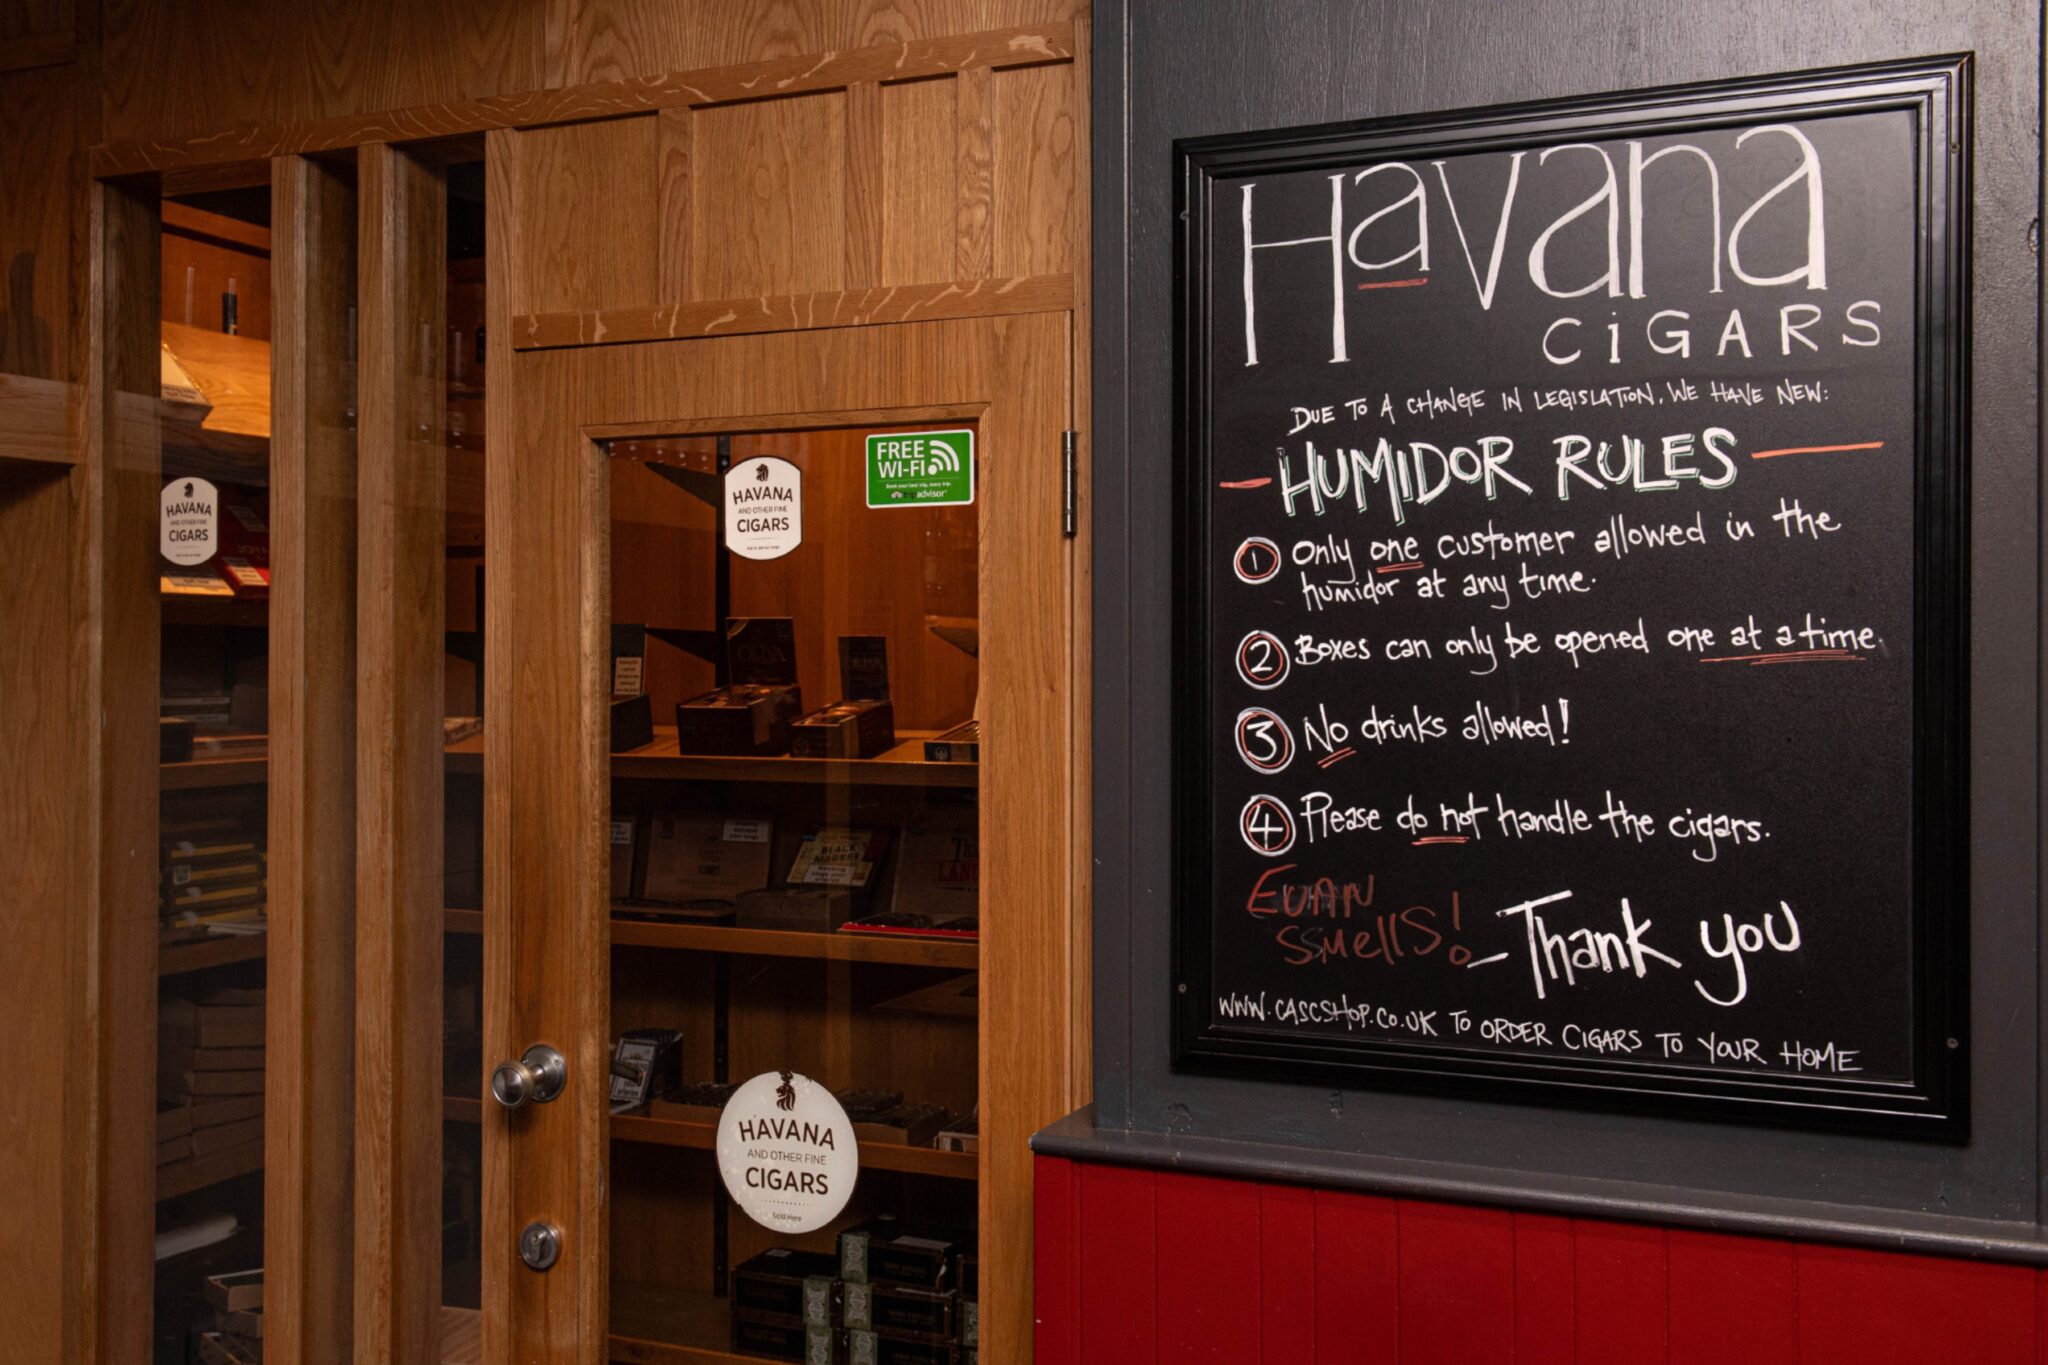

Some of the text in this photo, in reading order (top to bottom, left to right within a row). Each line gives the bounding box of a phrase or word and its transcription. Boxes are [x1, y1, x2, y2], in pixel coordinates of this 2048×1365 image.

[1240, 123, 1828, 366] Havana
[1286, 405, 1336, 436] DUE
[1380, 392, 1396, 425] A
[1406, 386, 1486, 420] CHANGE
[1501, 386, 1523, 413] IN
[1667, 378, 1699, 404] WE
[1710, 380, 1764, 407] HAVE
[877, 440, 925, 461] FREE
[877, 460, 926, 479] WI-FI
[1276, 427, 1739, 527] HUMIDOR RULES
[166, 502, 212, 518] HAVANA
[733, 486, 793, 505] HAVANA
[738, 505, 788, 514] AND OTHER FINE
[168, 529, 209, 542] CIGARS
[737, 517, 790, 533] CIGARS
[1292, 534, 1356, 584] Only
[1370, 536, 1420, 563] one
[1437, 519, 1575, 561] customer
[1594, 510, 1706, 560] allowed
[1726, 511, 1756, 541] in
[1772, 497, 1842, 540] the
[1301, 561, 1597, 611] humidor at any time.
[1294, 634, 1372, 665] Boxes
[1386, 637, 1433, 660] can
[1445, 625, 1498, 676] only
[1503, 621, 1541, 659] be
[1554, 616, 1650, 669] opened
[1666, 625, 1716, 652] one
[1730, 614, 1763, 650] at
[1775, 625, 1796, 646] a
[1302, 703, 1349, 752] No
[1360, 704, 1448, 745] drinks
[1462, 697, 1570, 746] allowed!
[1300, 791, 1383, 843] Please
[1396, 794, 1428, 835] do
[1440, 791, 1489, 840] not
[1496, 792, 1593, 839] handle
[1598, 789, 1656, 843] the
[1668, 807, 1771, 863] cigars.
[814, 852, 860, 863] MARKET
[820, 842, 857, 854] BLACK
[1495, 889, 1801, 1006] Thank you
[1480, 1017, 1553, 1046] ORDER
[1562, 1023, 1642, 1054] CIGARS
[1697, 1031, 1768, 1064] YOUR
[1779, 1040, 1864, 1073] HOME
[738, 1117, 835, 1151] HAVANA
[747, 1148, 827, 1166] AND OTHER FINE
[745, 1166, 829, 1196] CIGARS
